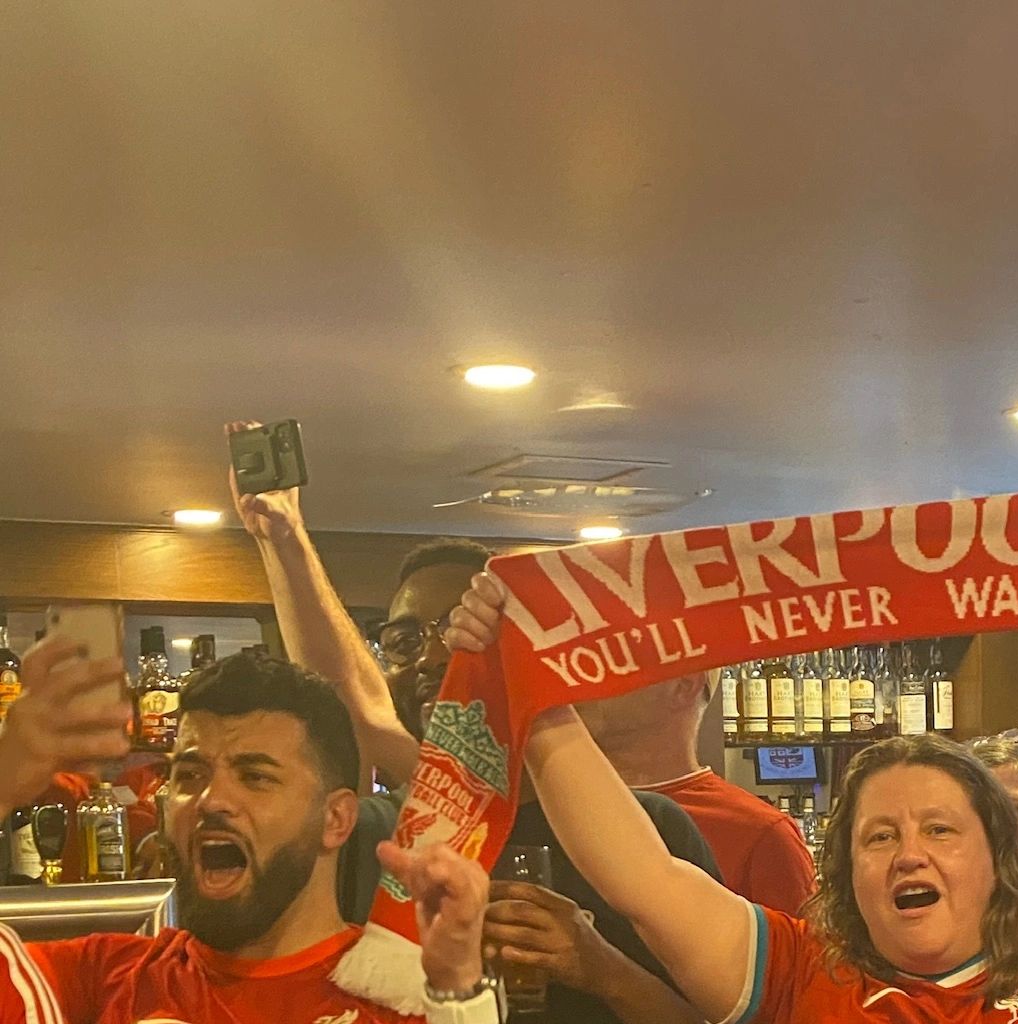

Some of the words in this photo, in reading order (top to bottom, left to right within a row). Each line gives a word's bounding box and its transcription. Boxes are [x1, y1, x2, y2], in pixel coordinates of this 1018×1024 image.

[540, 618, 706, 688] YOU'LL
[741, 586, 899, 645] NEVER
[416, 763, 476, 814] ERPOOL
